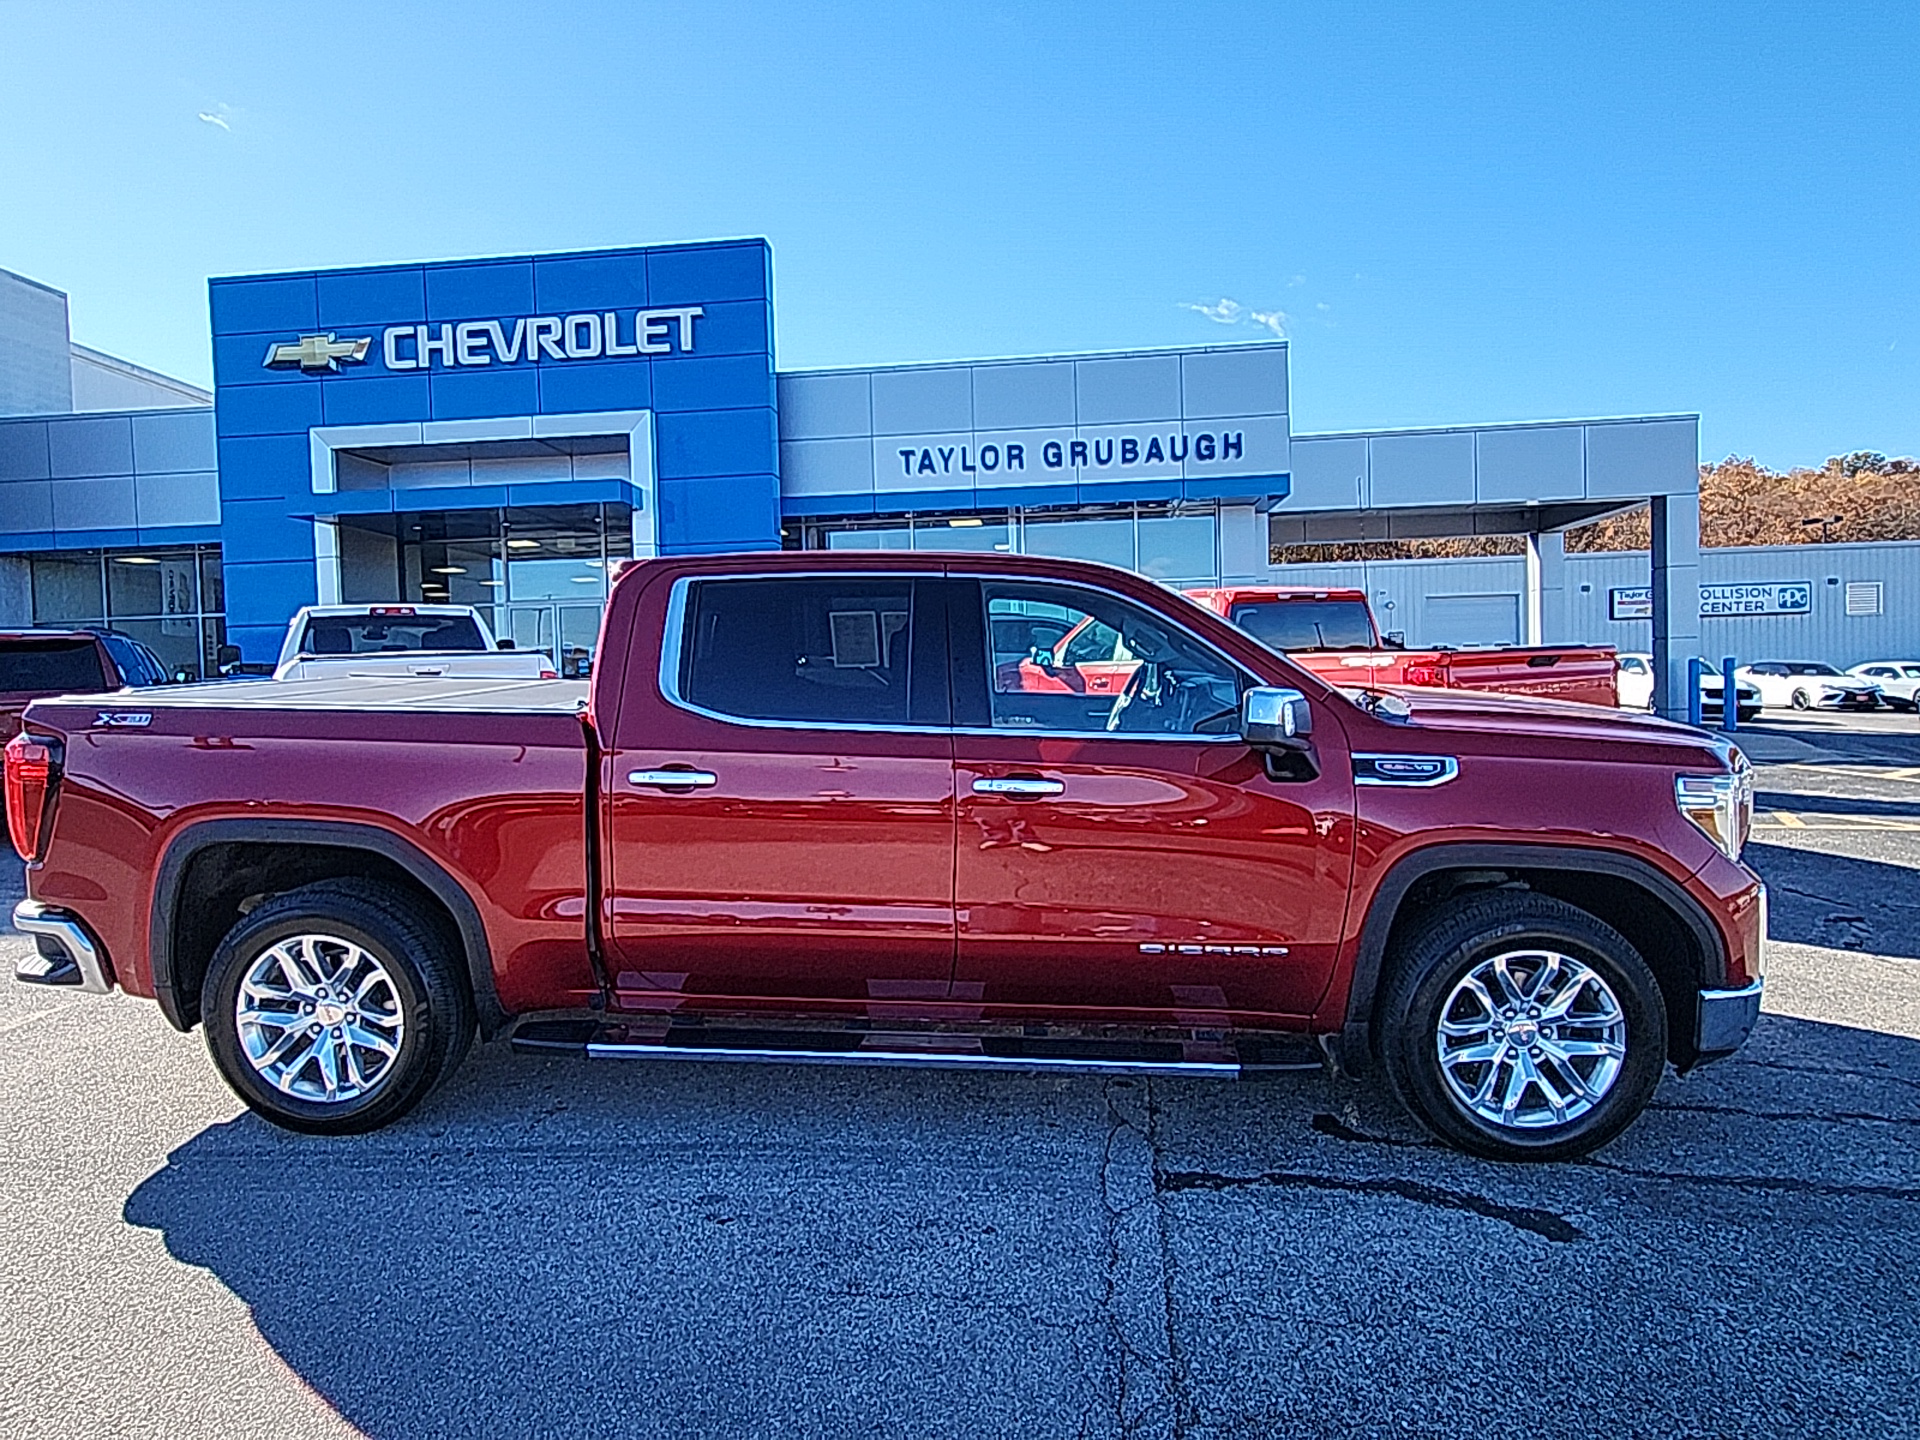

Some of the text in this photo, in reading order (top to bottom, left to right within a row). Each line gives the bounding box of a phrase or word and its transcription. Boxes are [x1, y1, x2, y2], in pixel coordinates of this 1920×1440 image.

[383, 306, 704, 370] CHEVROLET
[898, 432, 1242, 475] TAYLOR GRUBAUGH
[1700, 587, 1772, 600] OLLISION
[1779, 588, 1807, 607] PPG
[1700, 601, 1765, 612] CENTER
